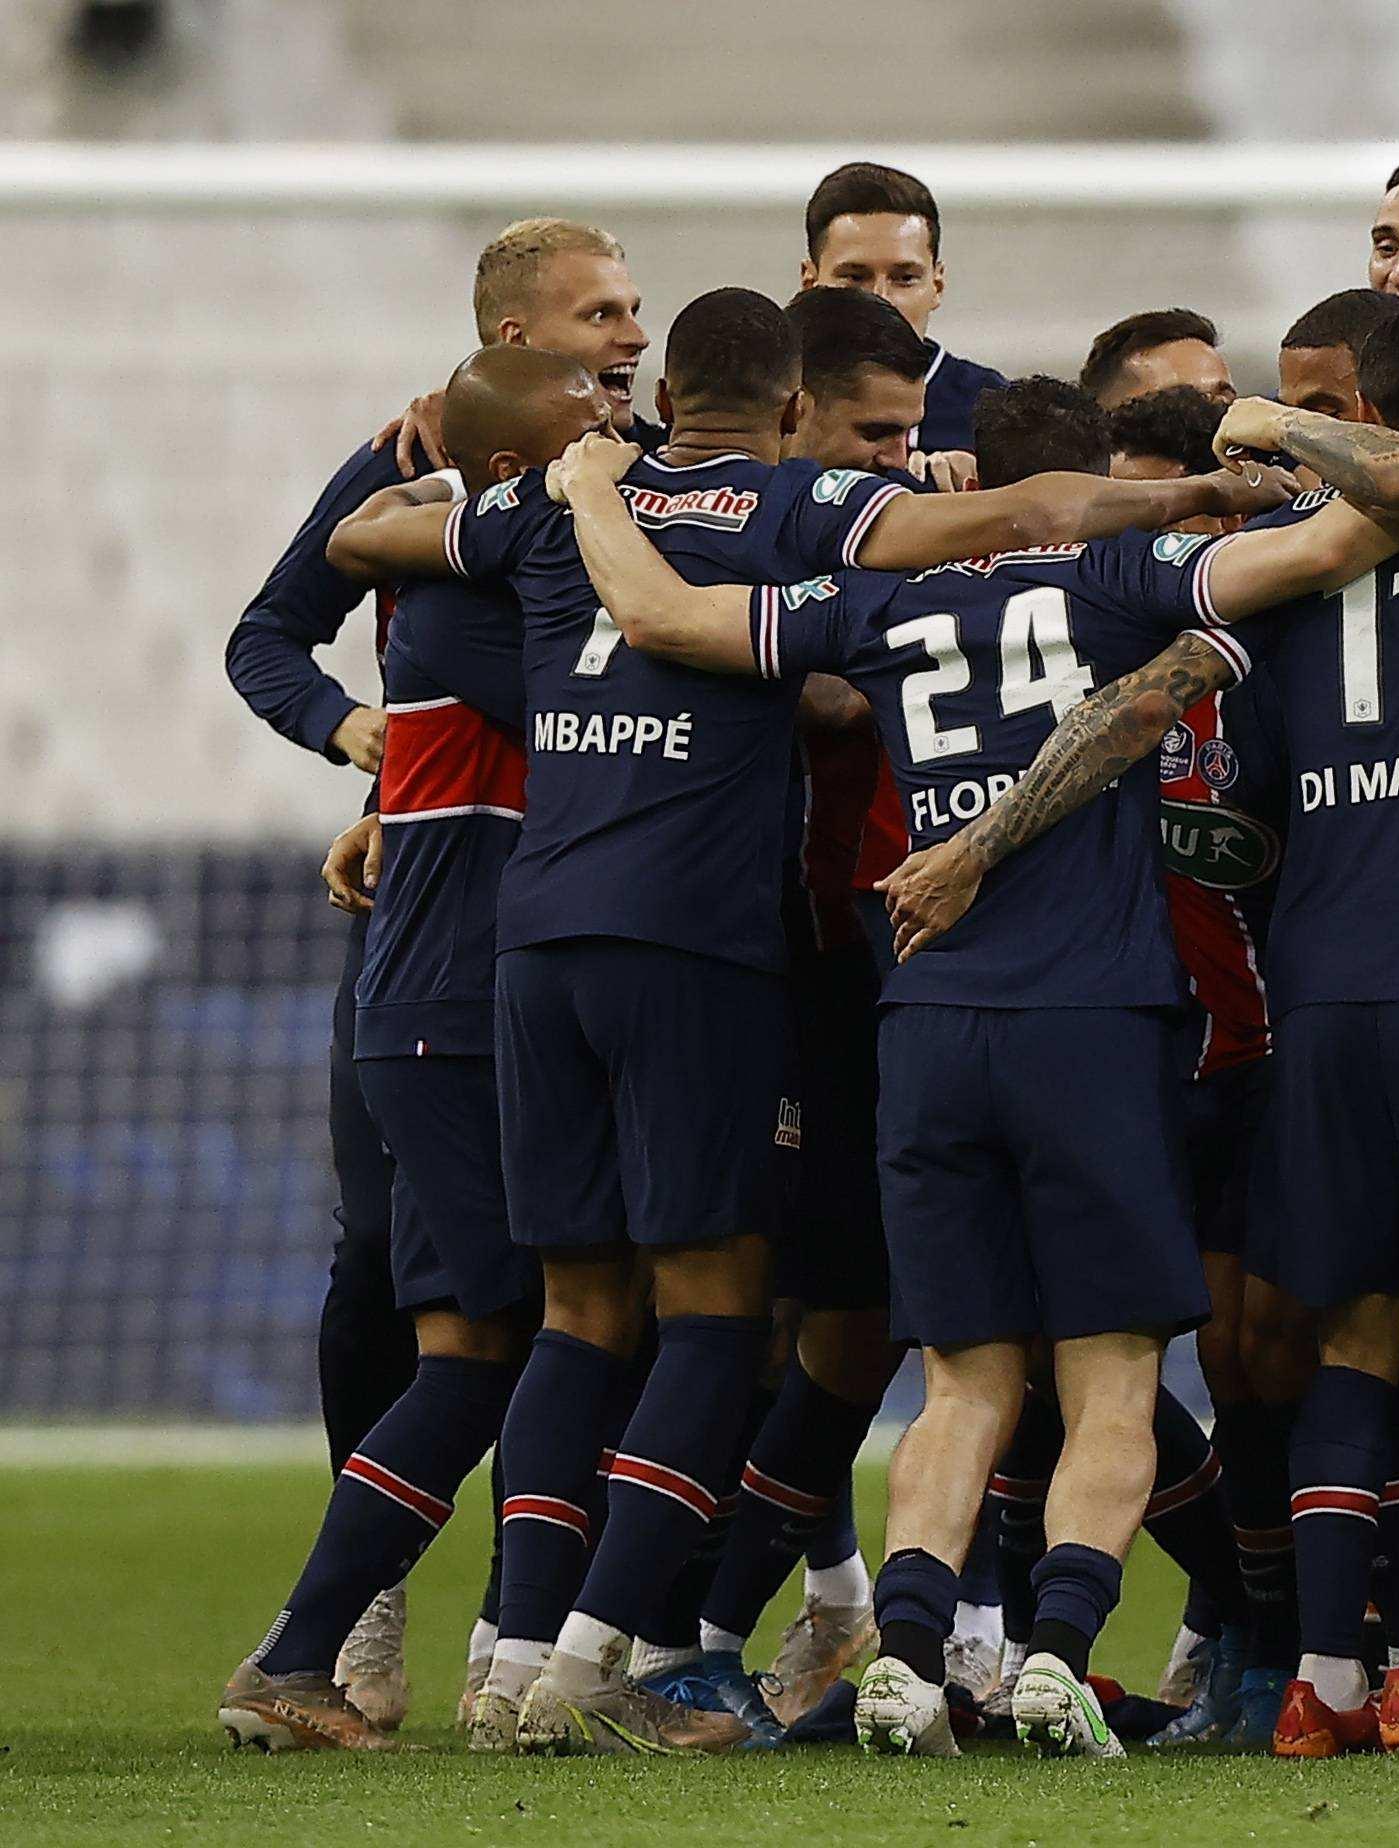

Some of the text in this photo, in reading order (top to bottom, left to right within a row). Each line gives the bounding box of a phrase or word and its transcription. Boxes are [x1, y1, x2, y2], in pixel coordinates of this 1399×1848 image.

[885, 586, 1094, 764] 24
[534, 712, 692, 761] MBAPPÉ
[911, 769, 1028, 832] FLOR
[1300, 767, 1336, 812] DI
